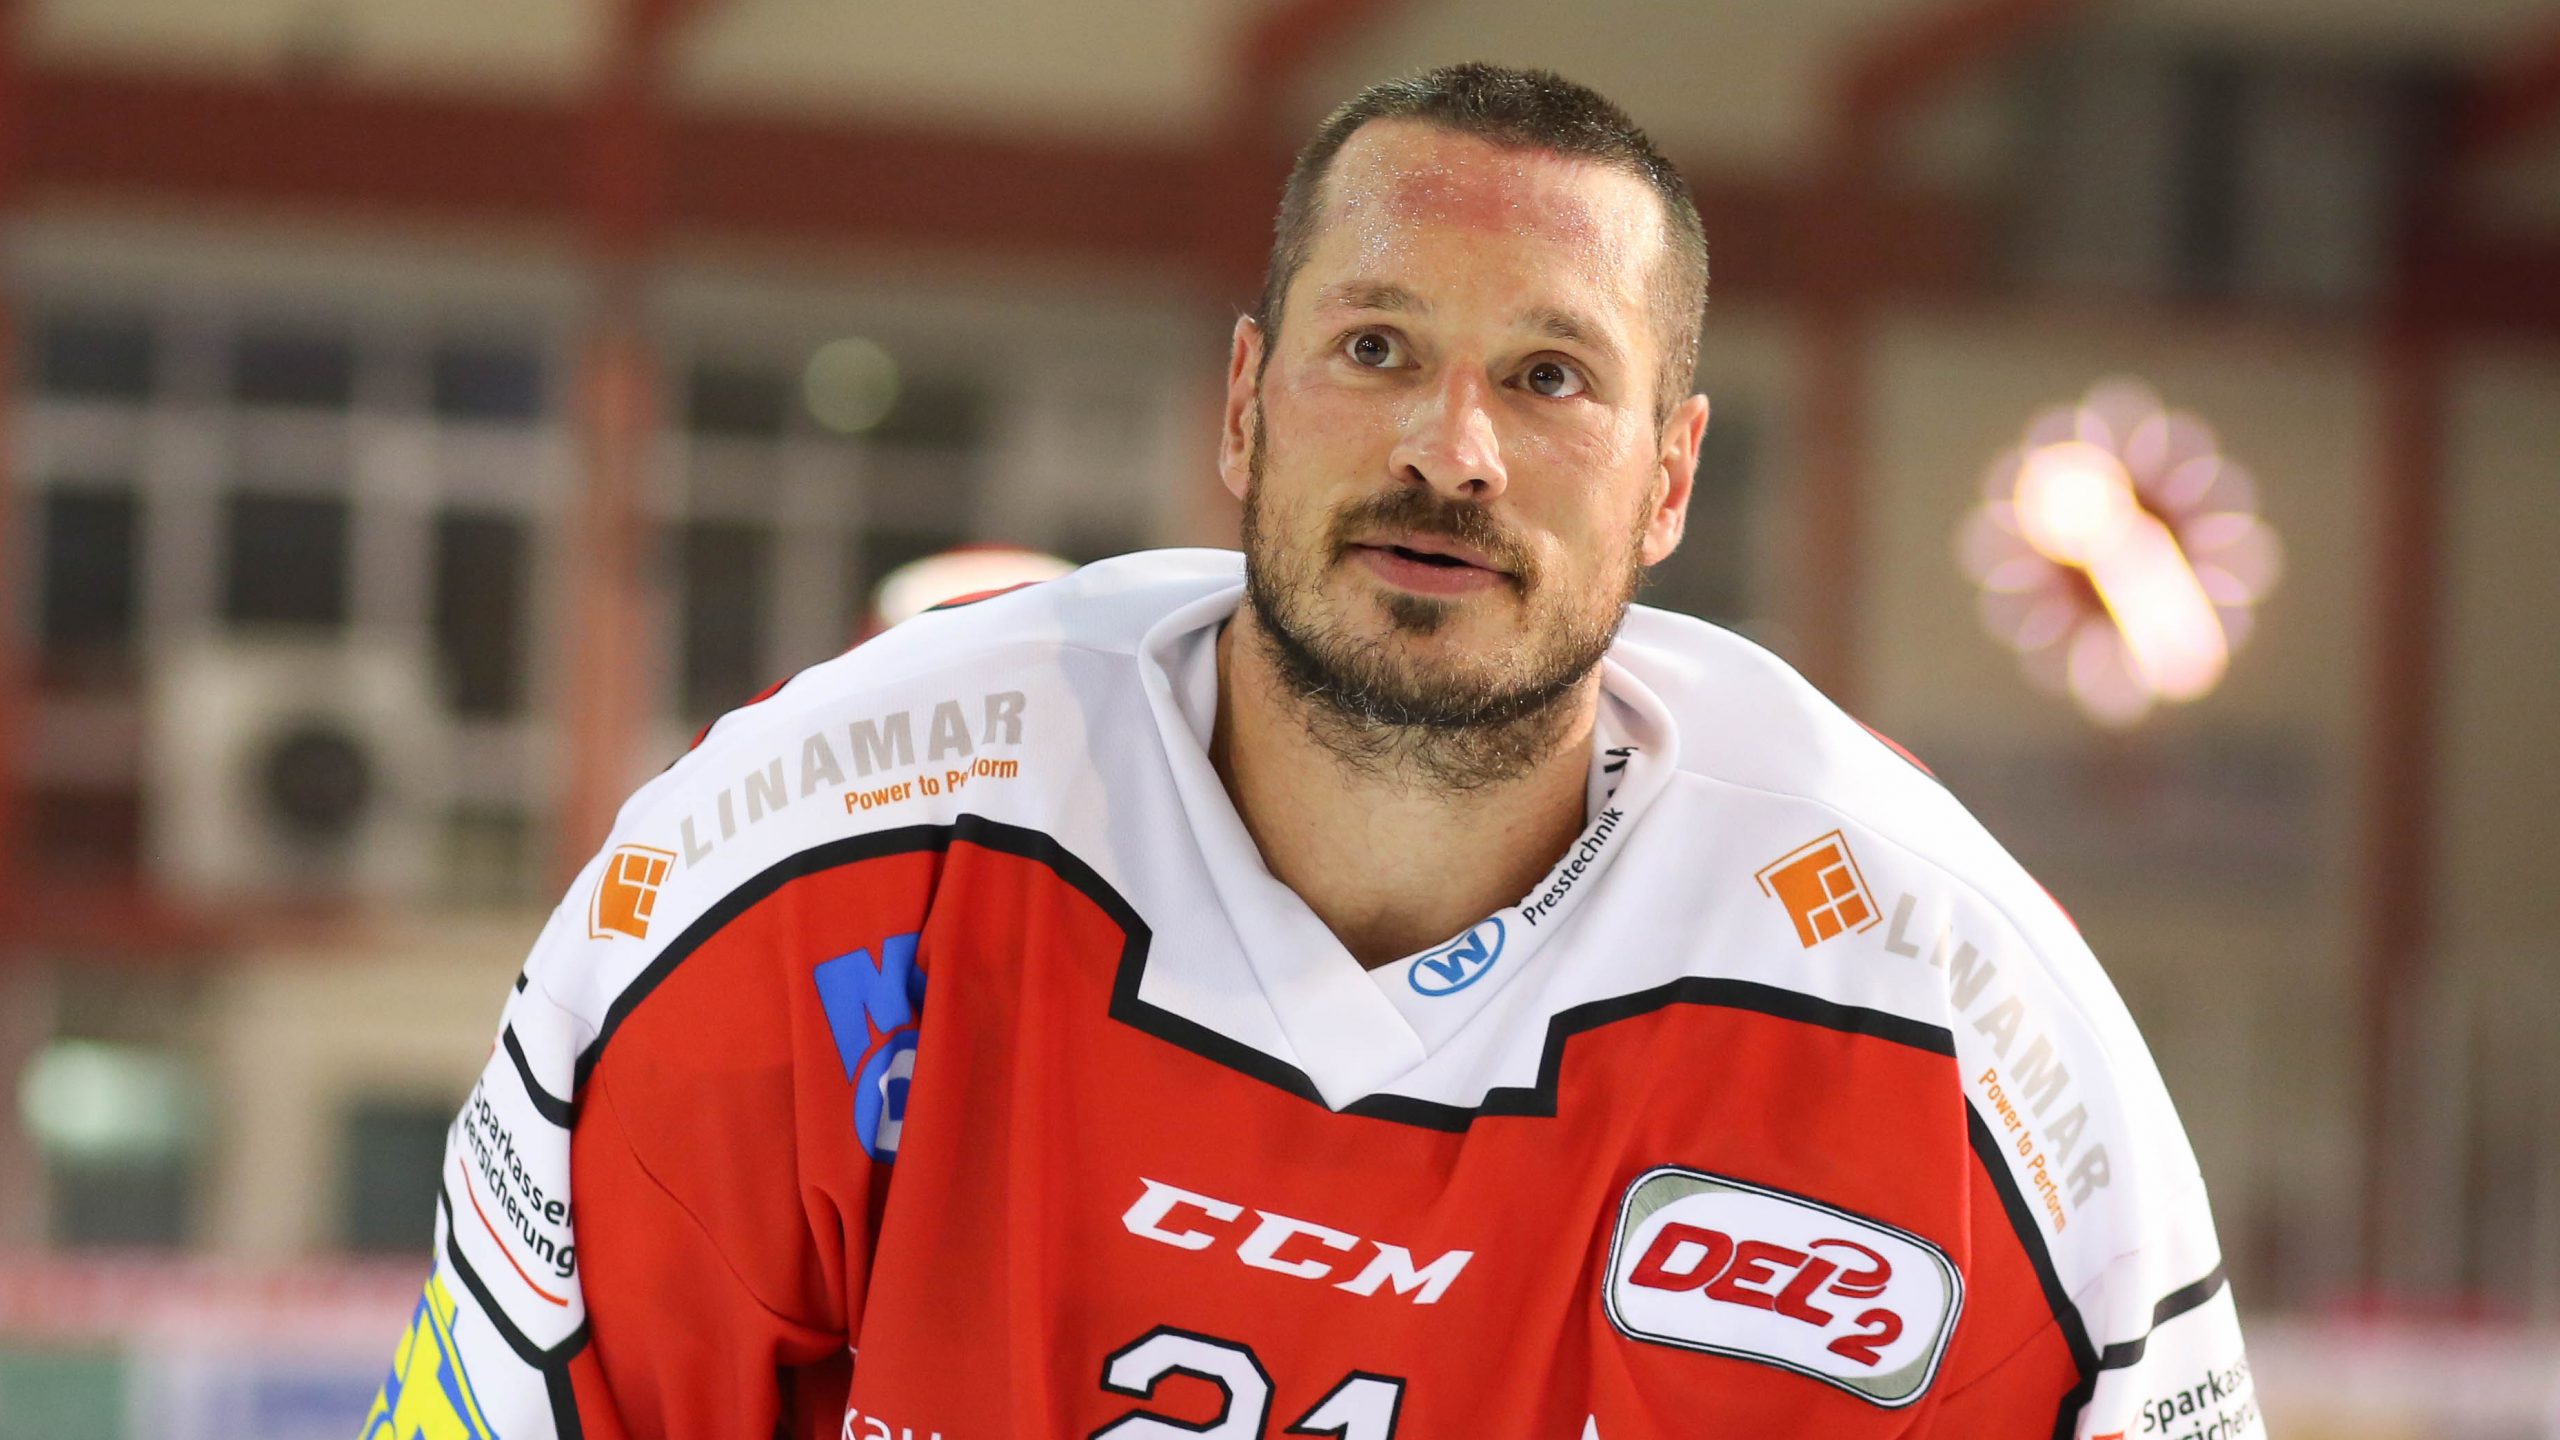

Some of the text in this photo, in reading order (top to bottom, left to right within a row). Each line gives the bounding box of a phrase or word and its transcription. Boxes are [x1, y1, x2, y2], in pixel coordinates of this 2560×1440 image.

[680, 690, 1027, 870] LINAMAR
[844, 780, 912, 815] Power
[918, 774, 940, 797] to
[1521, 806, 1624, 927] Presstechnik
[1422, 930, 1490, 985] W
[1884, 891, 2111, 1211] LINAMAR
[1977, 1067, 2067, 1235] Power to Perform
[1121, 1176, 1475, 1305] CCM
